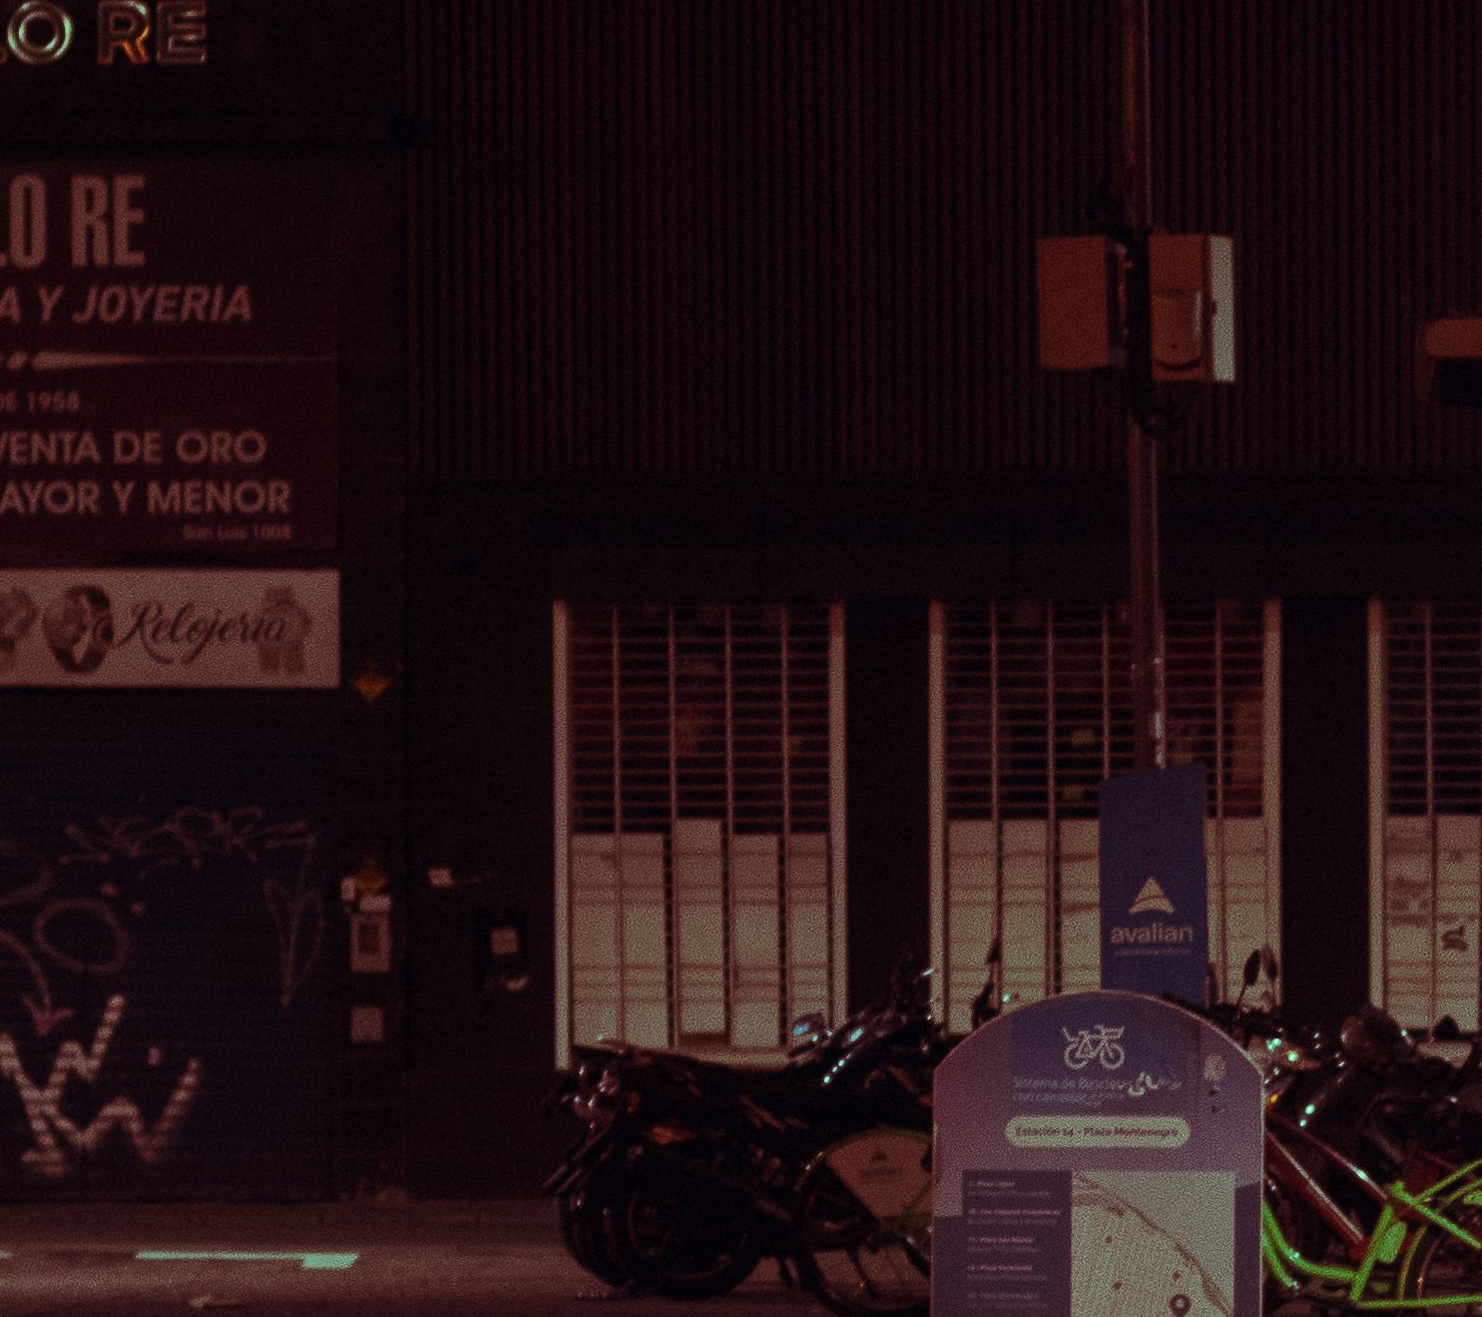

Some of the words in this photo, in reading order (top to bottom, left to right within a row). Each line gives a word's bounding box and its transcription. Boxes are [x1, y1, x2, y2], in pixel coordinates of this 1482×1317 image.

[70, 174, 146, 269] RE
[38, 284, 64, 324] Y
[71, 284, 254, 325] JOYERIA
[113, 430, 161, 466] DE
[175, 430, 268, 466] ORO
[110, 481, 135, 517] Y
[147, 481, 291, 517] MENOR
[1109, 922, 1195, 945] avalian
